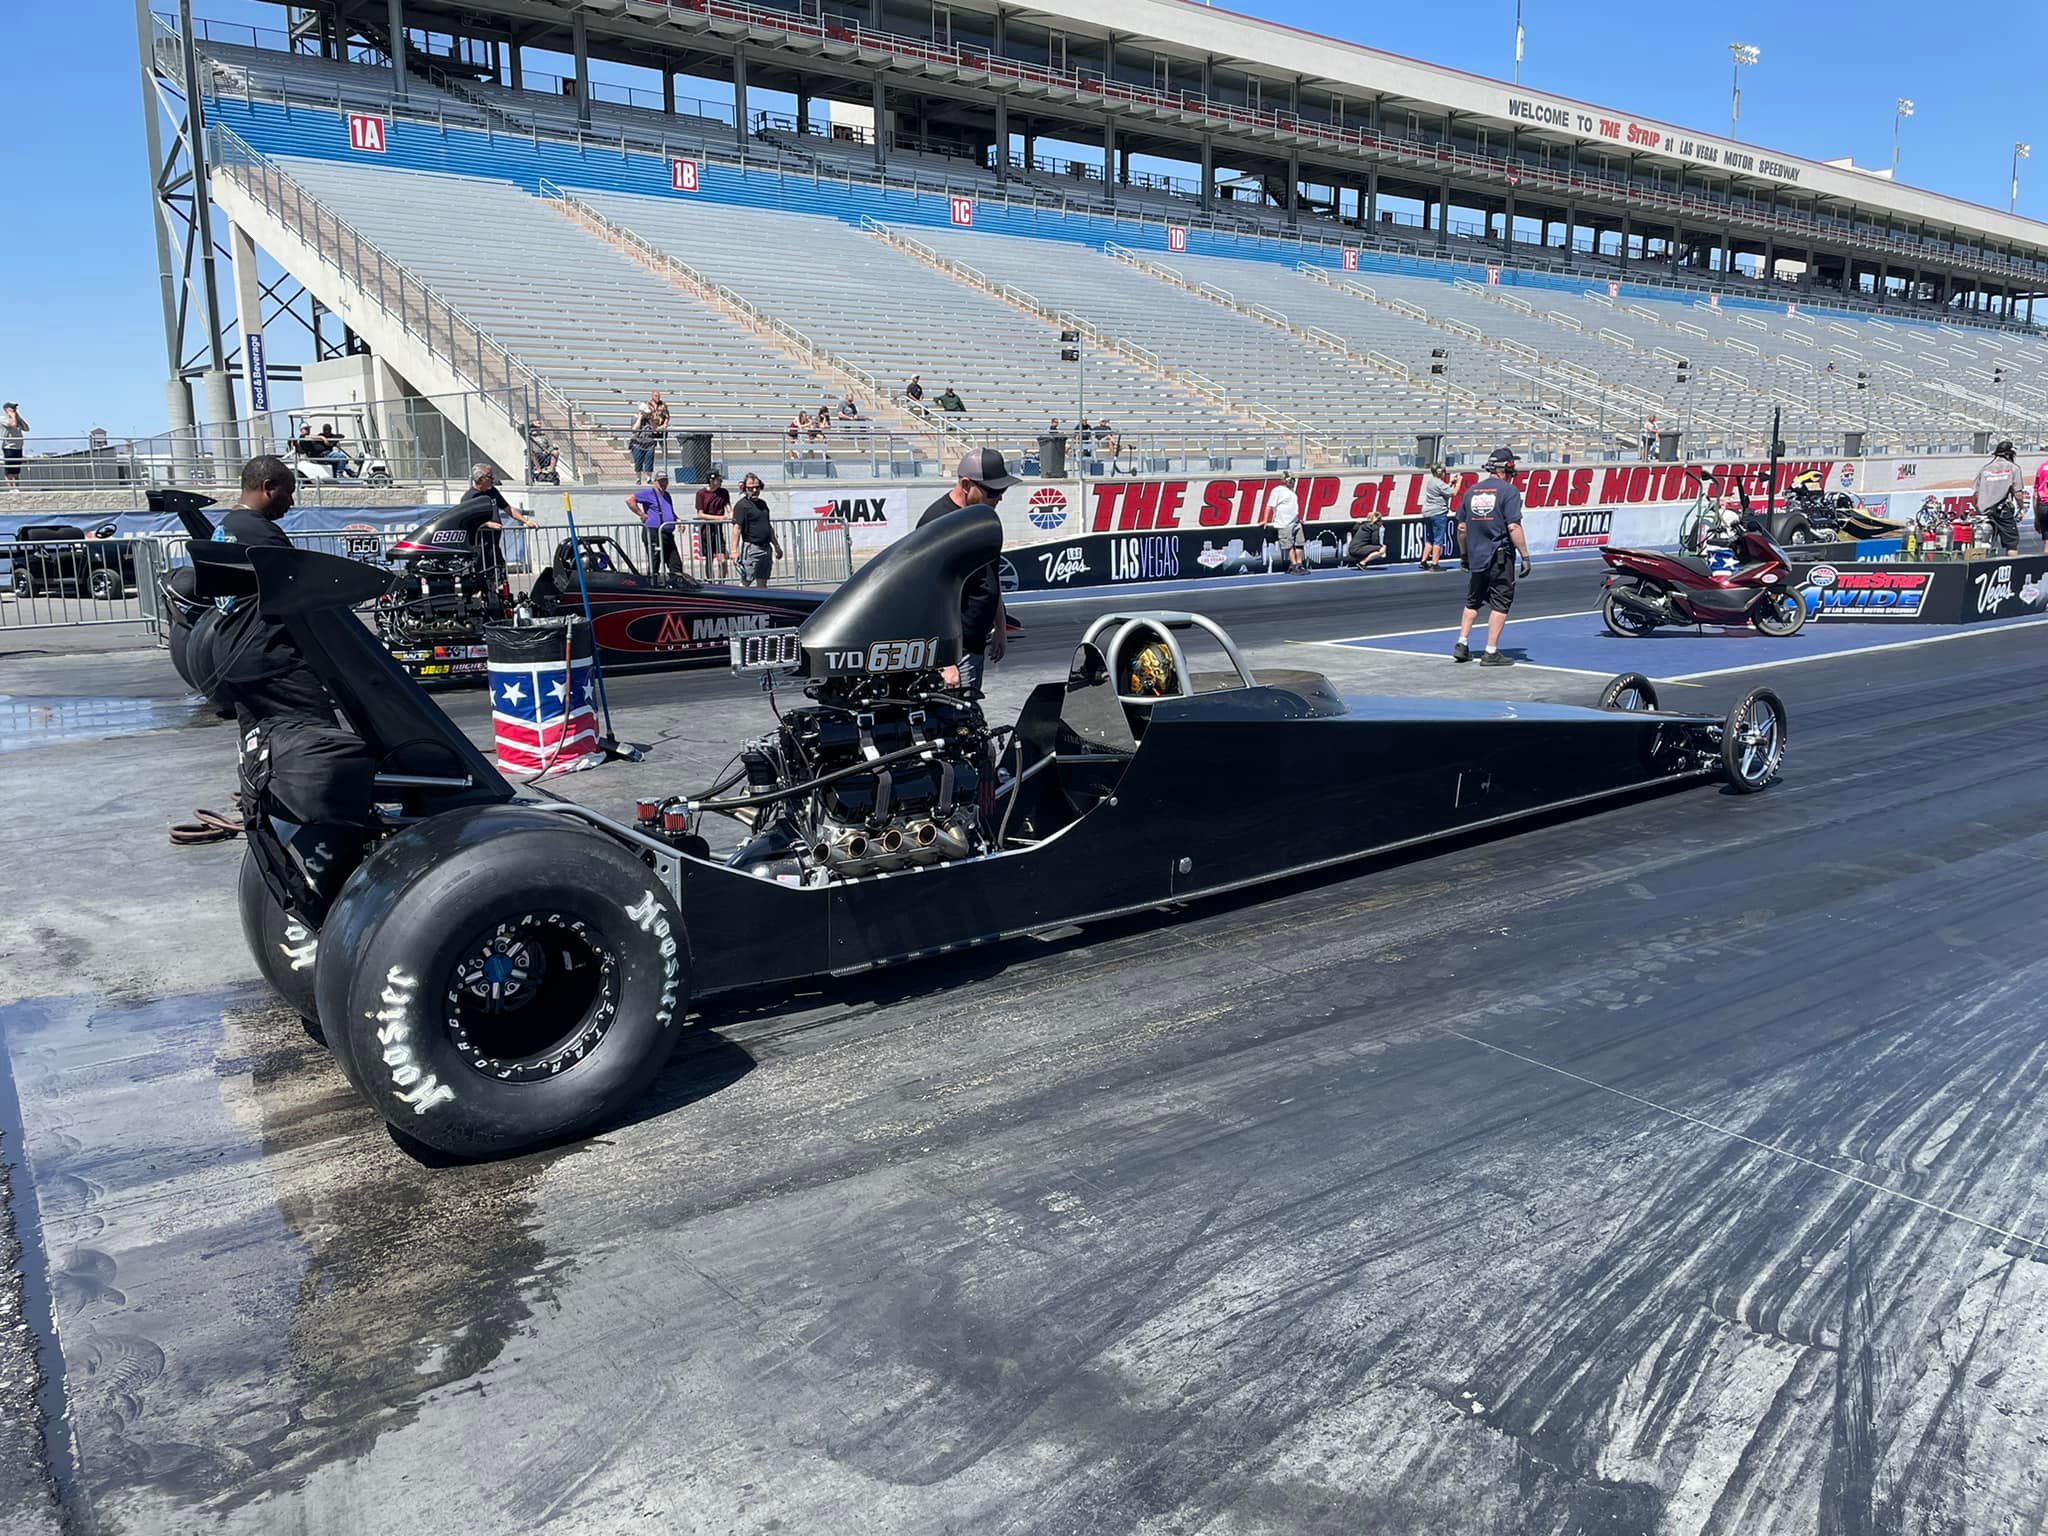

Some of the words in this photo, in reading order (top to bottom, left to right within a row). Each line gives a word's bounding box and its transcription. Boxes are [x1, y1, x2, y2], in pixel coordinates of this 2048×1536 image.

[353, 117, 381, 149] 1A
[1508, 98, 1569, 128] WELCOME
[1577, 114, 1593, 133] TO
[1599, 118, 1621, 140] THE
[1627, 122, 1660, 148] STRIP
[1665, 138, 1673, 152] at
[1680, 139, 1693, 156] LAS
[1696, 145, 1718, 163] VEGAS
[1723, 152, 1754, 171] MOTOR
[1758, 160, 1800, 182] SPEEDWAY
[675, 161, 695, 188] 1B
[954, 201, 970, 224] 1C
[1171, 229, 1184, 249] 1D
[1345, 251, 1356, 269] 1E
[251, 335, 262, 378] Beverage
[254, 387, 264, 410] Food
[1092, 480, 1188, 532] THE
[1350, 475, 1396, 518] at
[1599, 465, 1703, 504] MOTOR
[1561, 513, 1610, 535] OPTIMA
[1038, 550, 1092, 583] Vegas
[1975, 570, 2015, 614] Vegas
[692, 614, 771, 640] MANKE
[824, 651, 864, 669] T/D
[866, 636, 940, 674] 6301
[496, 914, 585, 936] RACE
[624, 889, 680, 1028] Hoosier
[448, 963, 512, 1079] FORGED
[365, 964, 457, 1115] Hoosier
[551, 1003, 615, 1074] STAR
